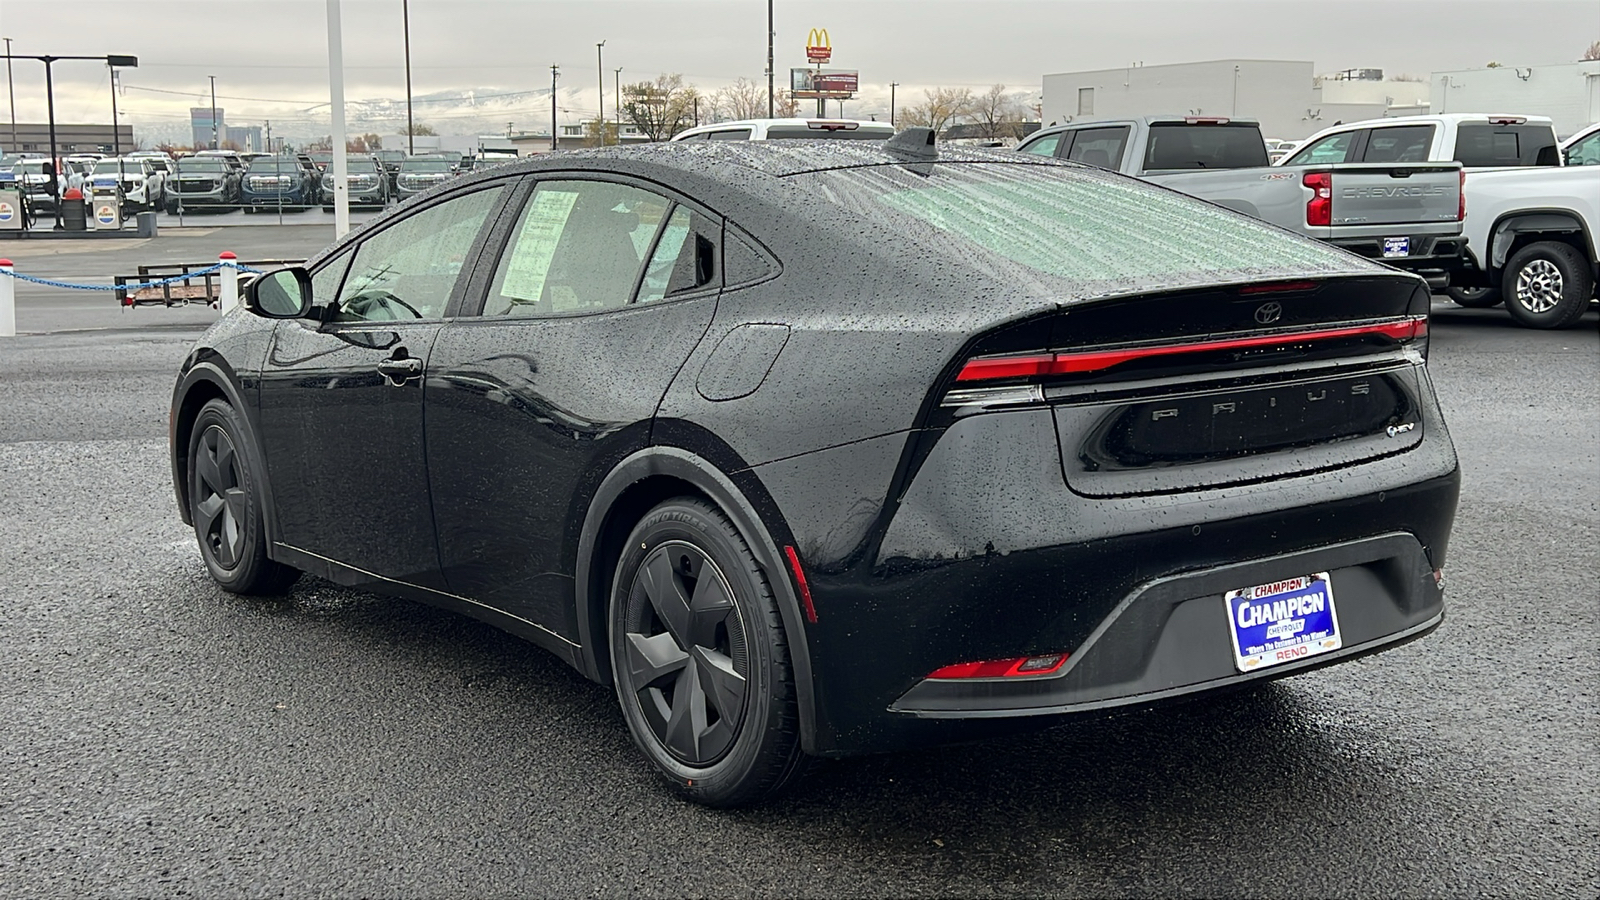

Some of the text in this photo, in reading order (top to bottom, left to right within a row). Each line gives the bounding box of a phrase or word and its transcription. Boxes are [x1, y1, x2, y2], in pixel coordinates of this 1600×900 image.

[1342, 185, 1454, 199] CHEVROLET
[1152, 384, 1370, 421] PRIUS
[1254, 578, 1302, 597] CHAMPION
[1237, 592, 1325, 628] CHAMPION
[1268, 621, 1303, 635] CHEVROLET
[1276, 646, 1308, 661] RENO
